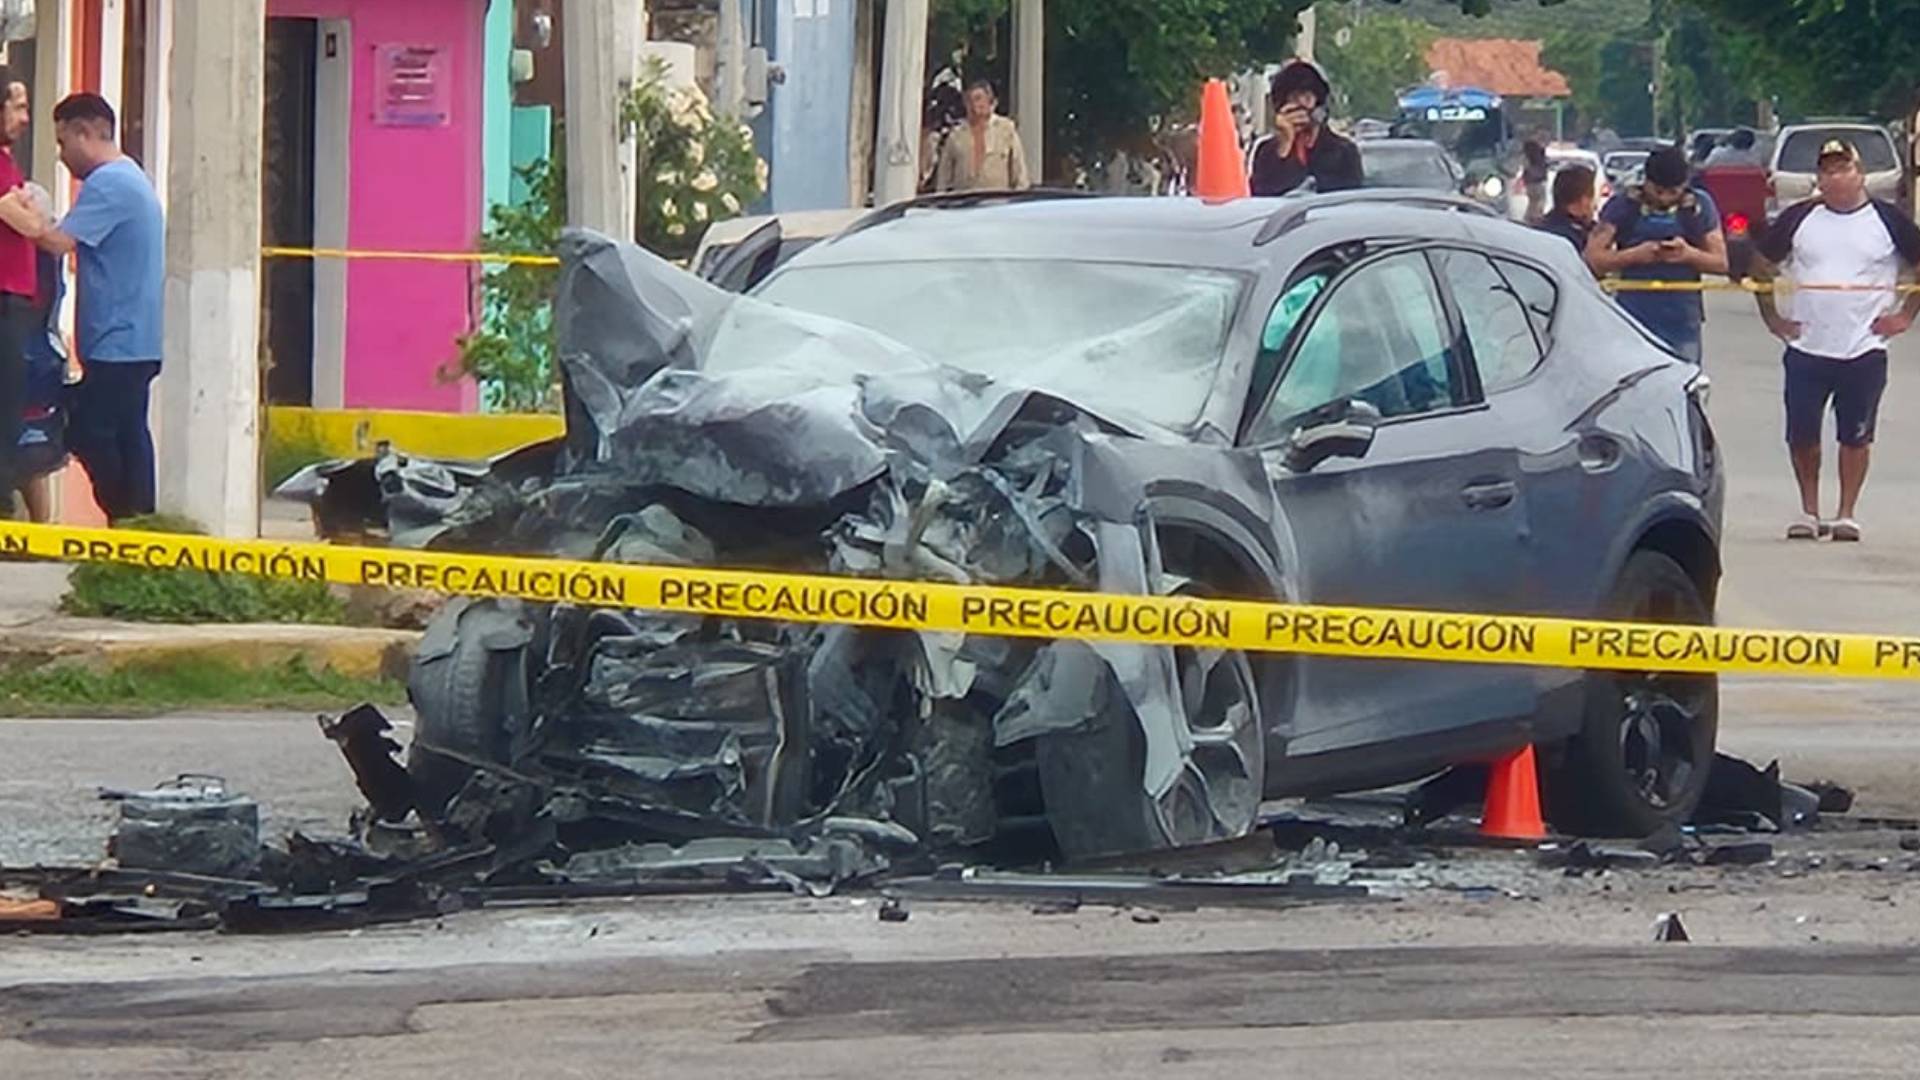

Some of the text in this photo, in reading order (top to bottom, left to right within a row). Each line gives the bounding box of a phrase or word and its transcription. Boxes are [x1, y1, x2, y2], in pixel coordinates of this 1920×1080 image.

[361, 560, 626, 602] PRECAUCIÓN
[660, 579, 928, 622] PRECAUCIÓN
[962, 597, 1231, 638] PRECAUCIÓN
